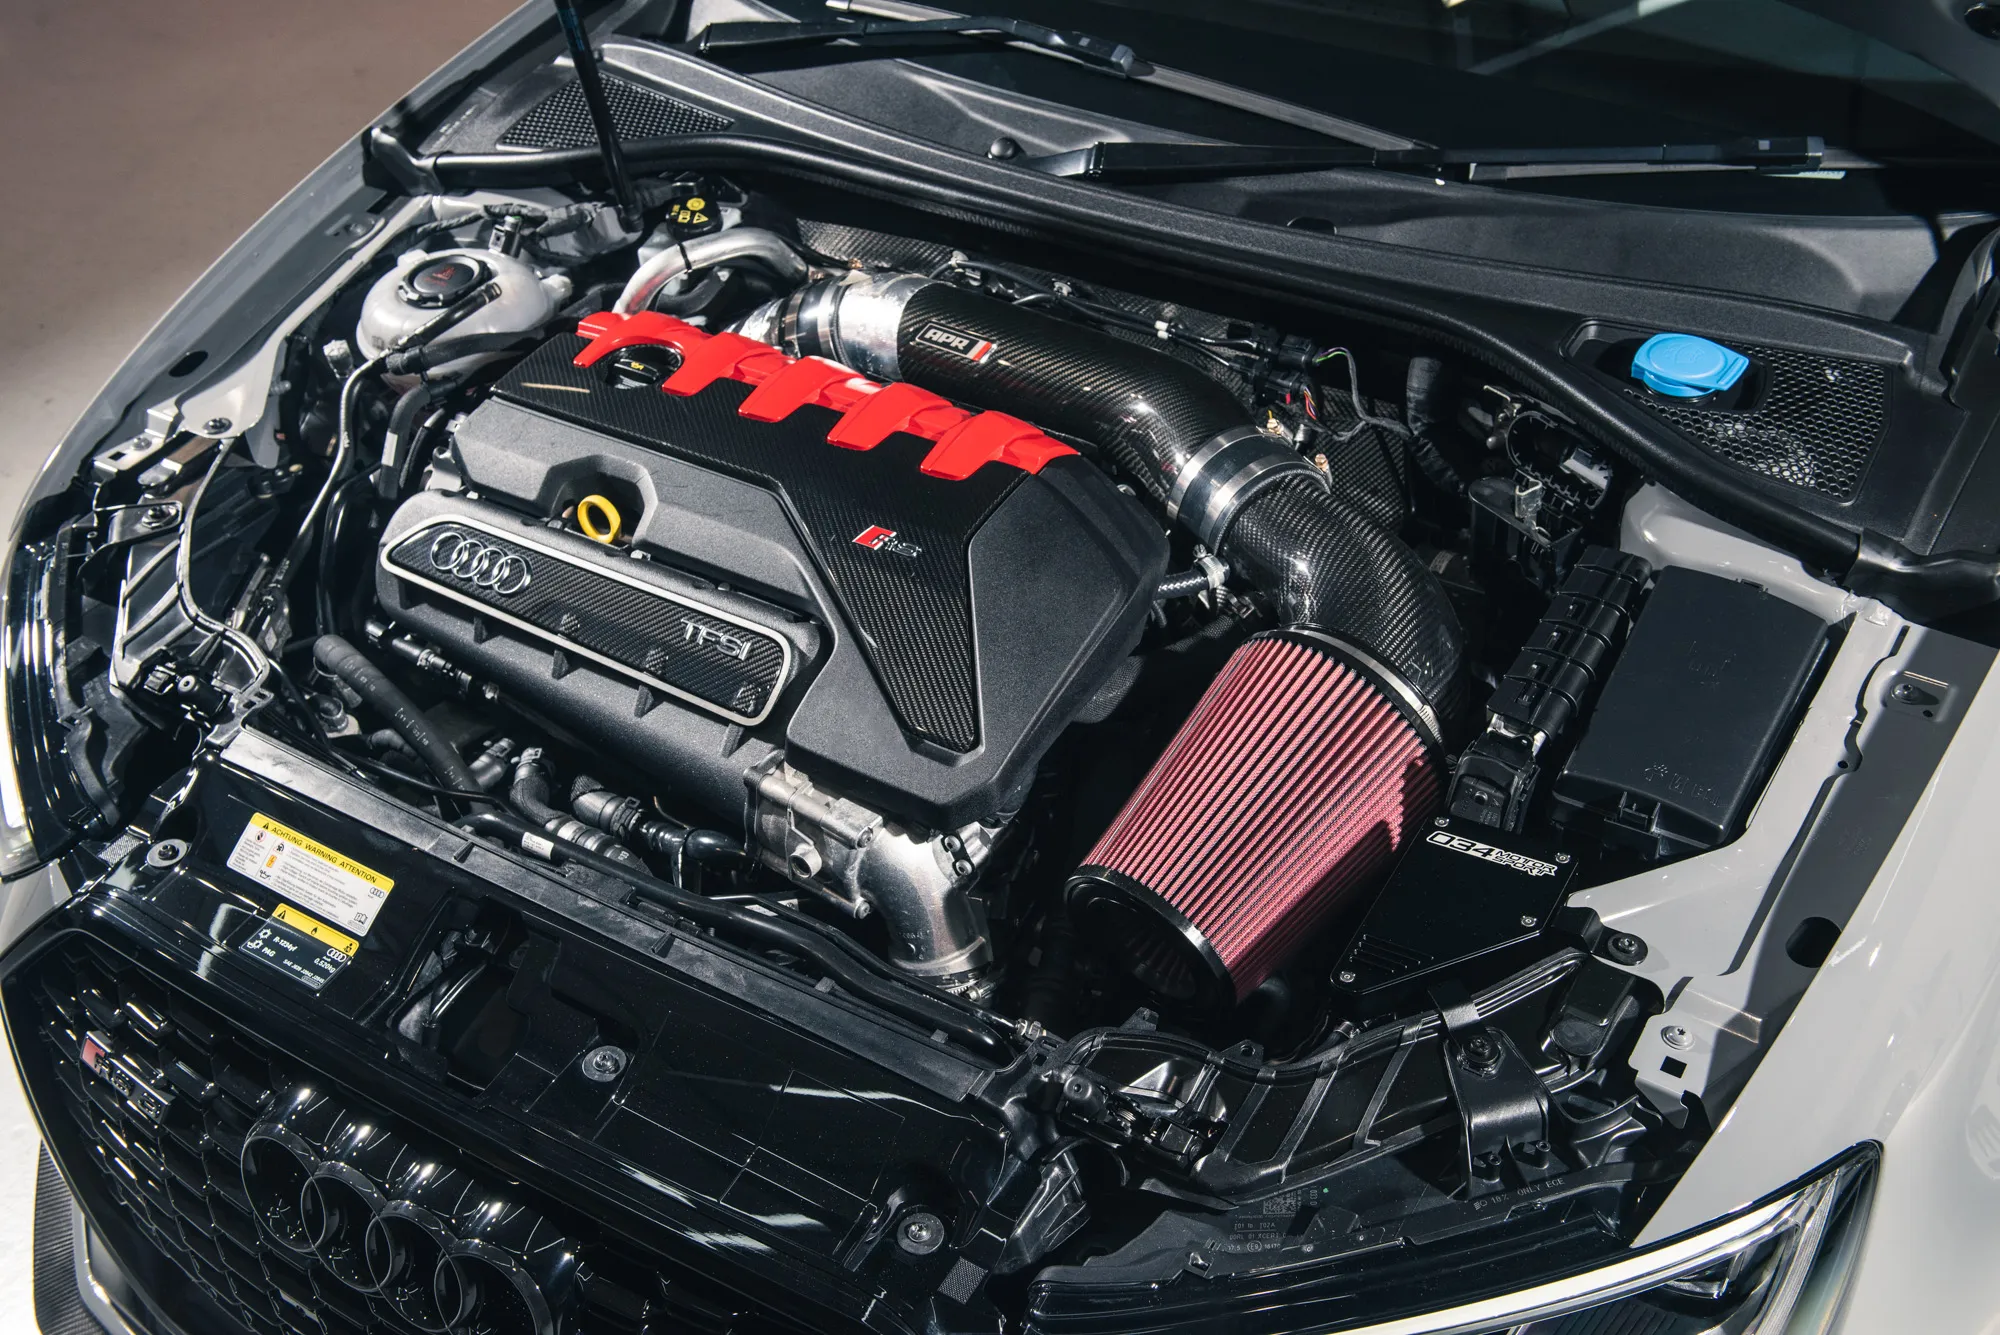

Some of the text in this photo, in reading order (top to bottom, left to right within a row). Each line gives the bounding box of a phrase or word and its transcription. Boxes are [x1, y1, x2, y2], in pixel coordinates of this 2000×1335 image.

[923, 328, 970, 350] APR
[680, 618, 752, 661] TFSI
[271, 827, 303, 846] ACHTUNG
[305, 844, 338, 864] WARNING
[340, 861, 377, 884] ATTENTION
[1428, 832, 1496, 859] 034
[1493, 855, 1549, 877] SPORT
[1496, 850, 1557, 875] MOTOR
[262, 947, 276, 957] PAG
[272, 936, 298, 952] R-1234yf
[314, 958, 336, 973] 0,520kg
[1517, 1184, 1541, 1196] ONLY
[1545, 1177, 1565, 1188] ECE
